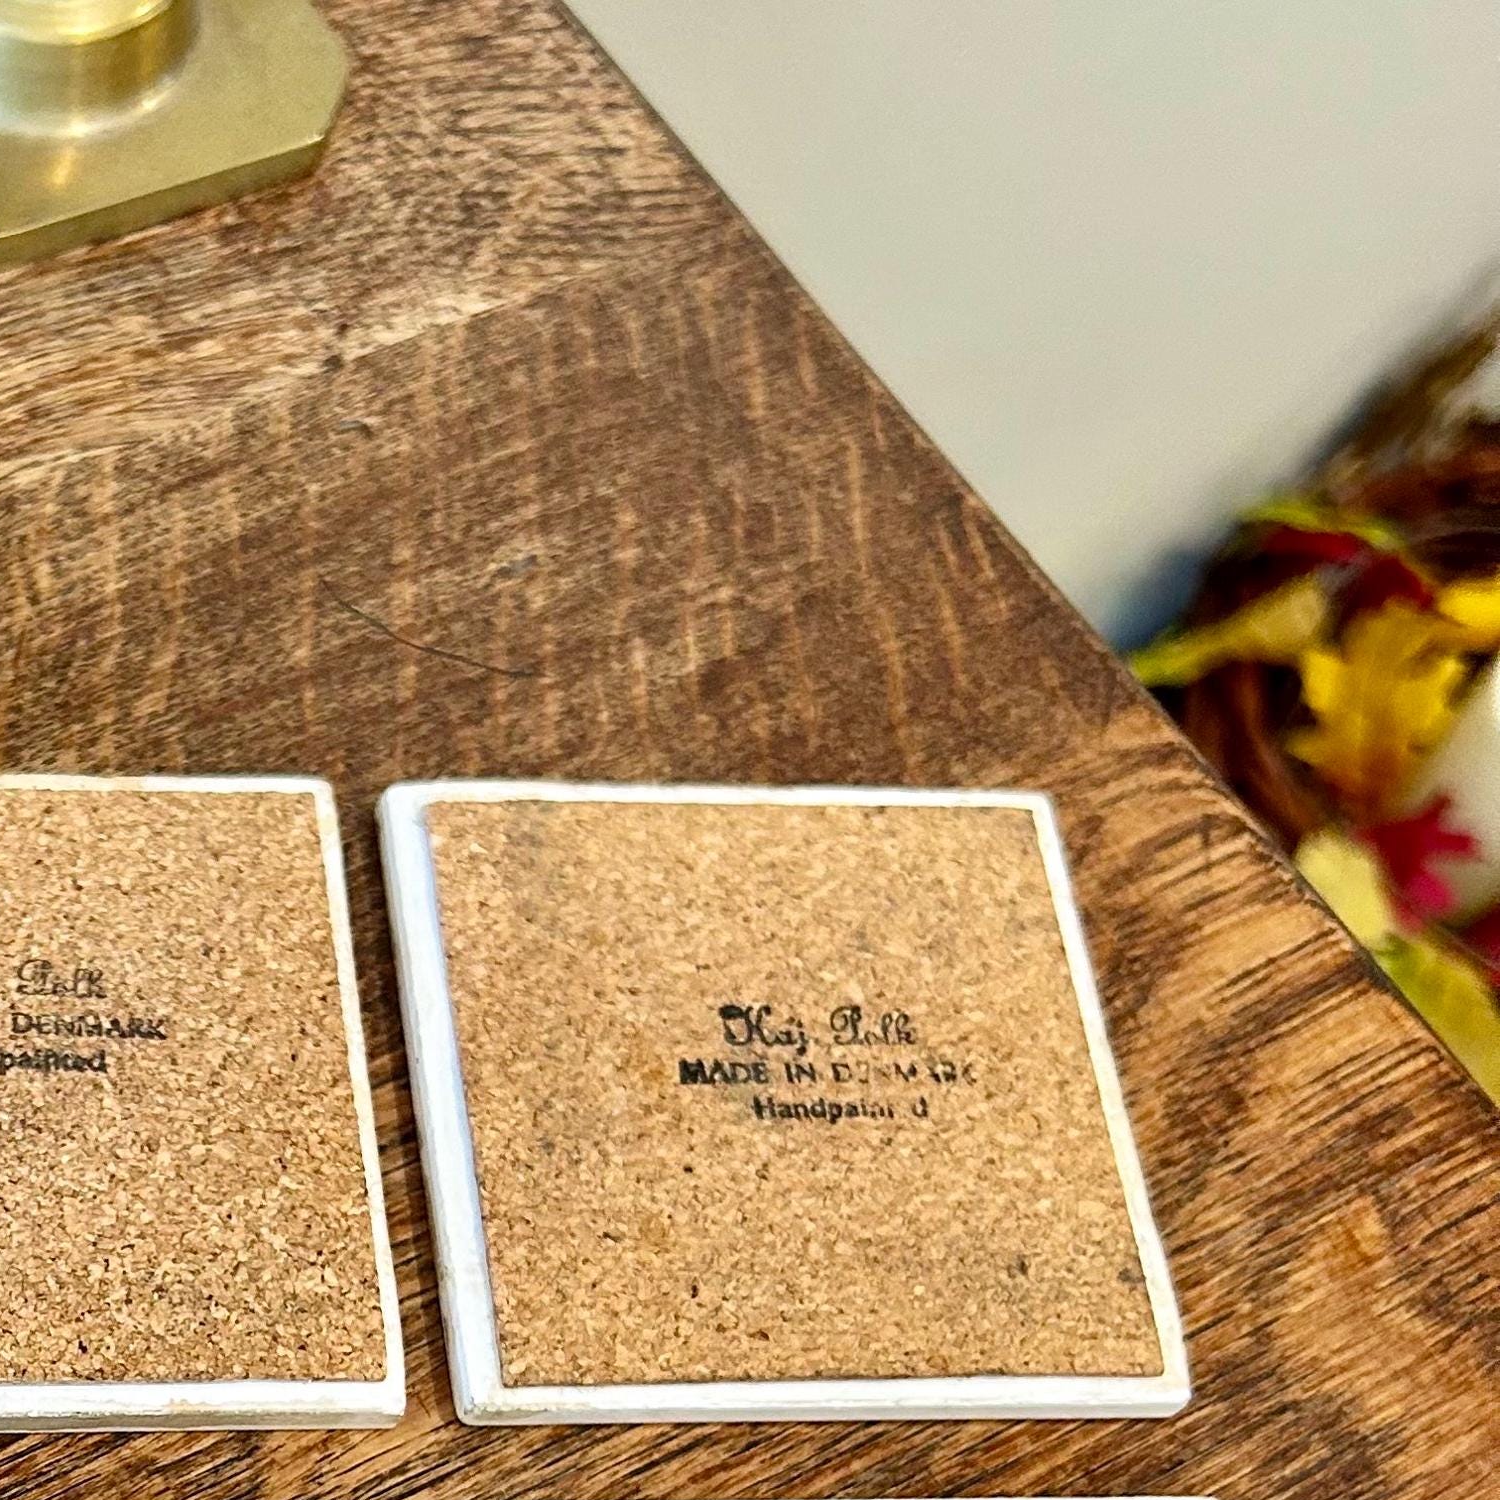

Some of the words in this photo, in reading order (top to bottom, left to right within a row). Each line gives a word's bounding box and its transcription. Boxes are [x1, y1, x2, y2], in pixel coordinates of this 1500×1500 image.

[11, 1013, 167, 1040] DENMARK
[719, 1005, 811, 1056] Kaj
[679, 1059, 770, 1084] MADE
[785, 1063, 816, 1082] IN
[753, 1097, 928, 1124] Handpaintd
